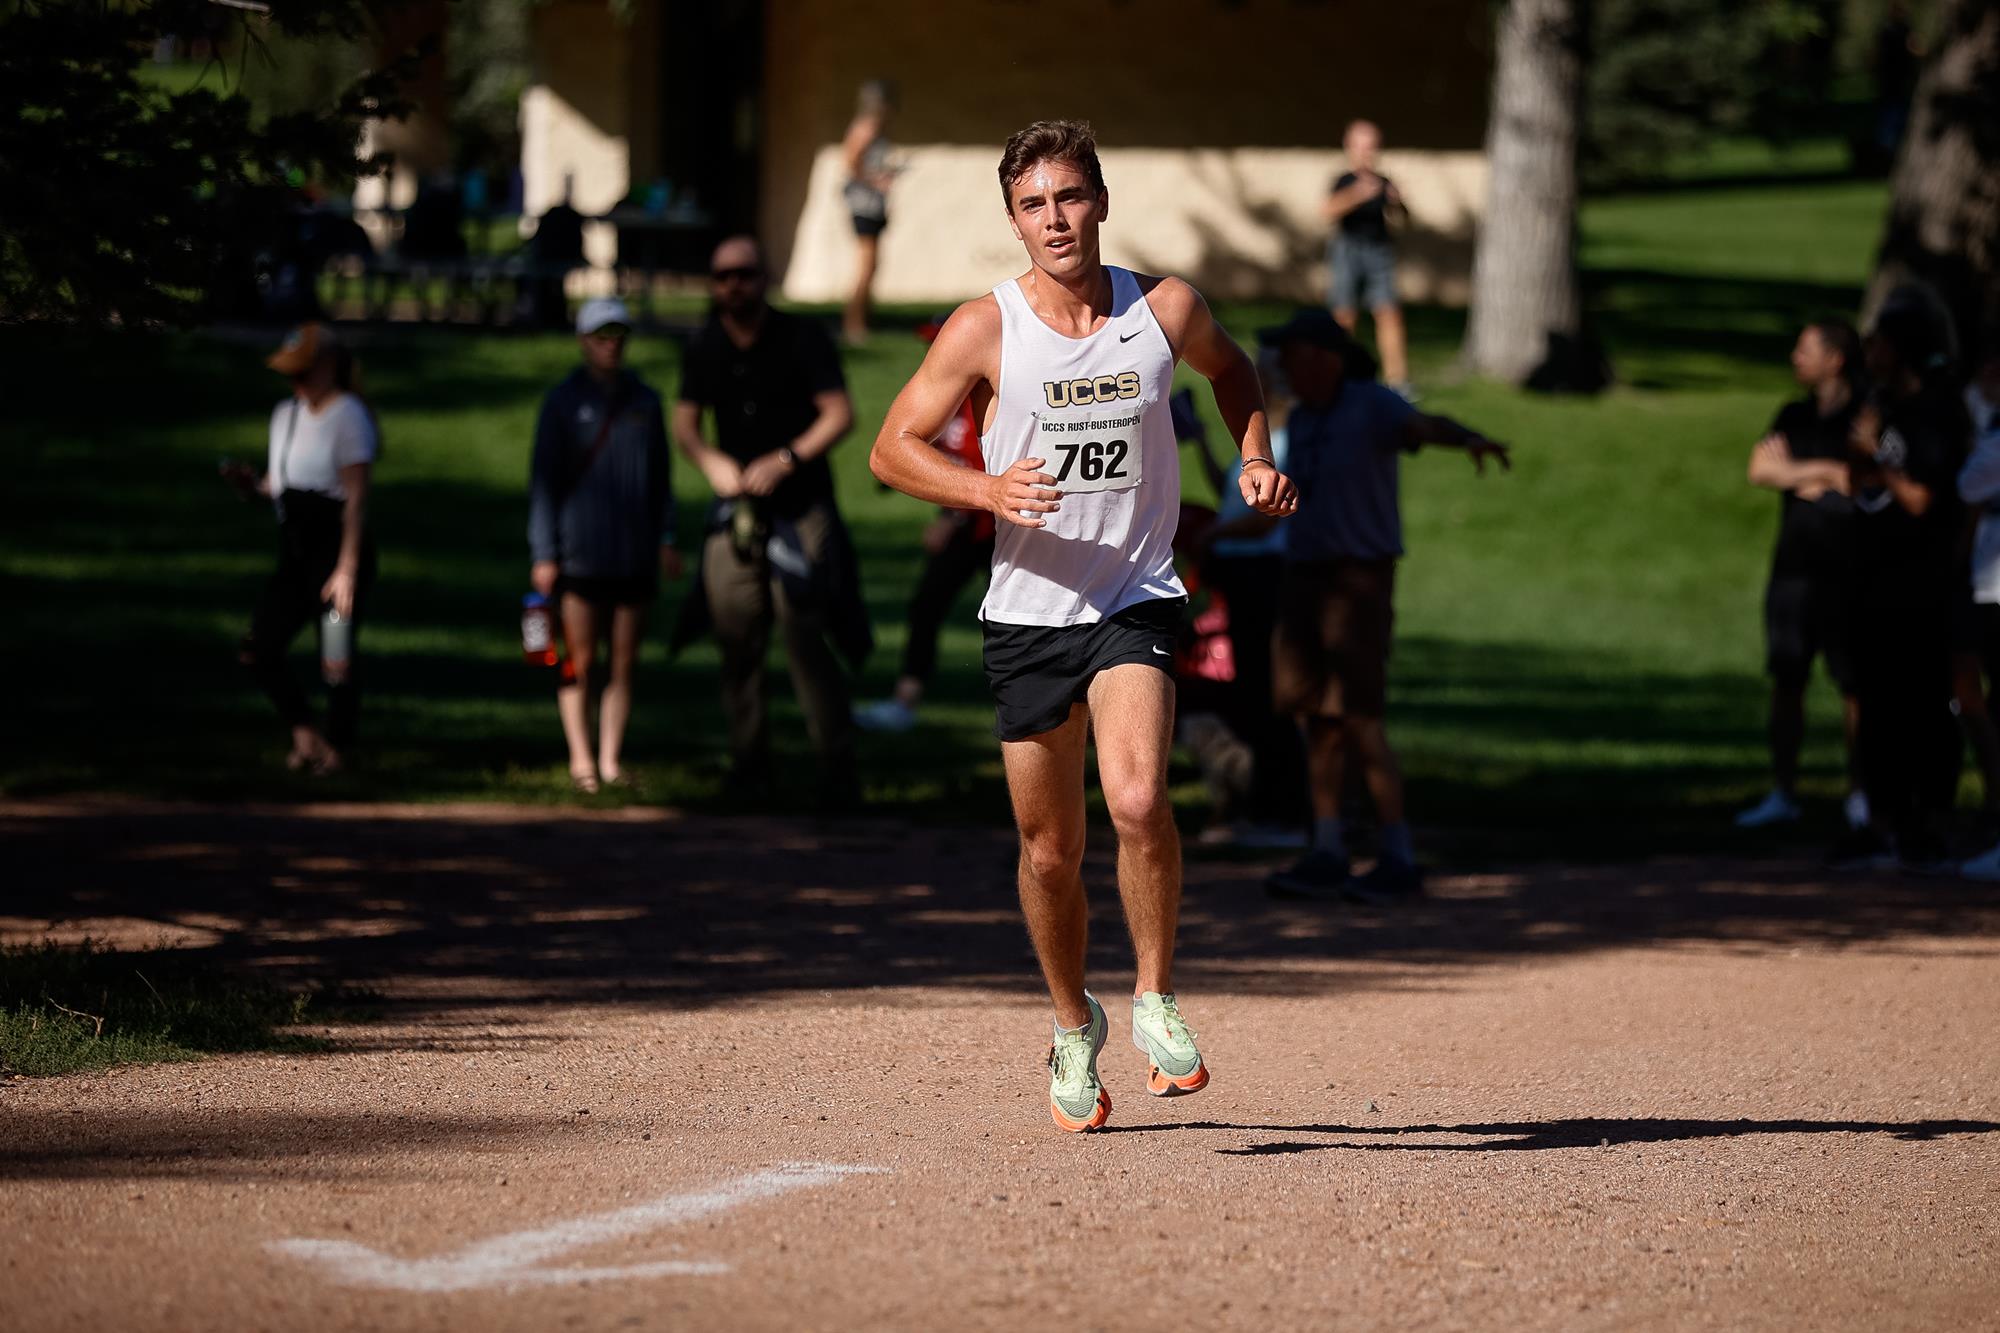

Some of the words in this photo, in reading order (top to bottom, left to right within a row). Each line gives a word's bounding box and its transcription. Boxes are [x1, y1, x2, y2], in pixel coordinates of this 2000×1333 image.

[1043, 371, 1140, 408] UCCS
[1042, 422, 1065, 432] UCCS
[1055, 440, 1129, 481] 762
